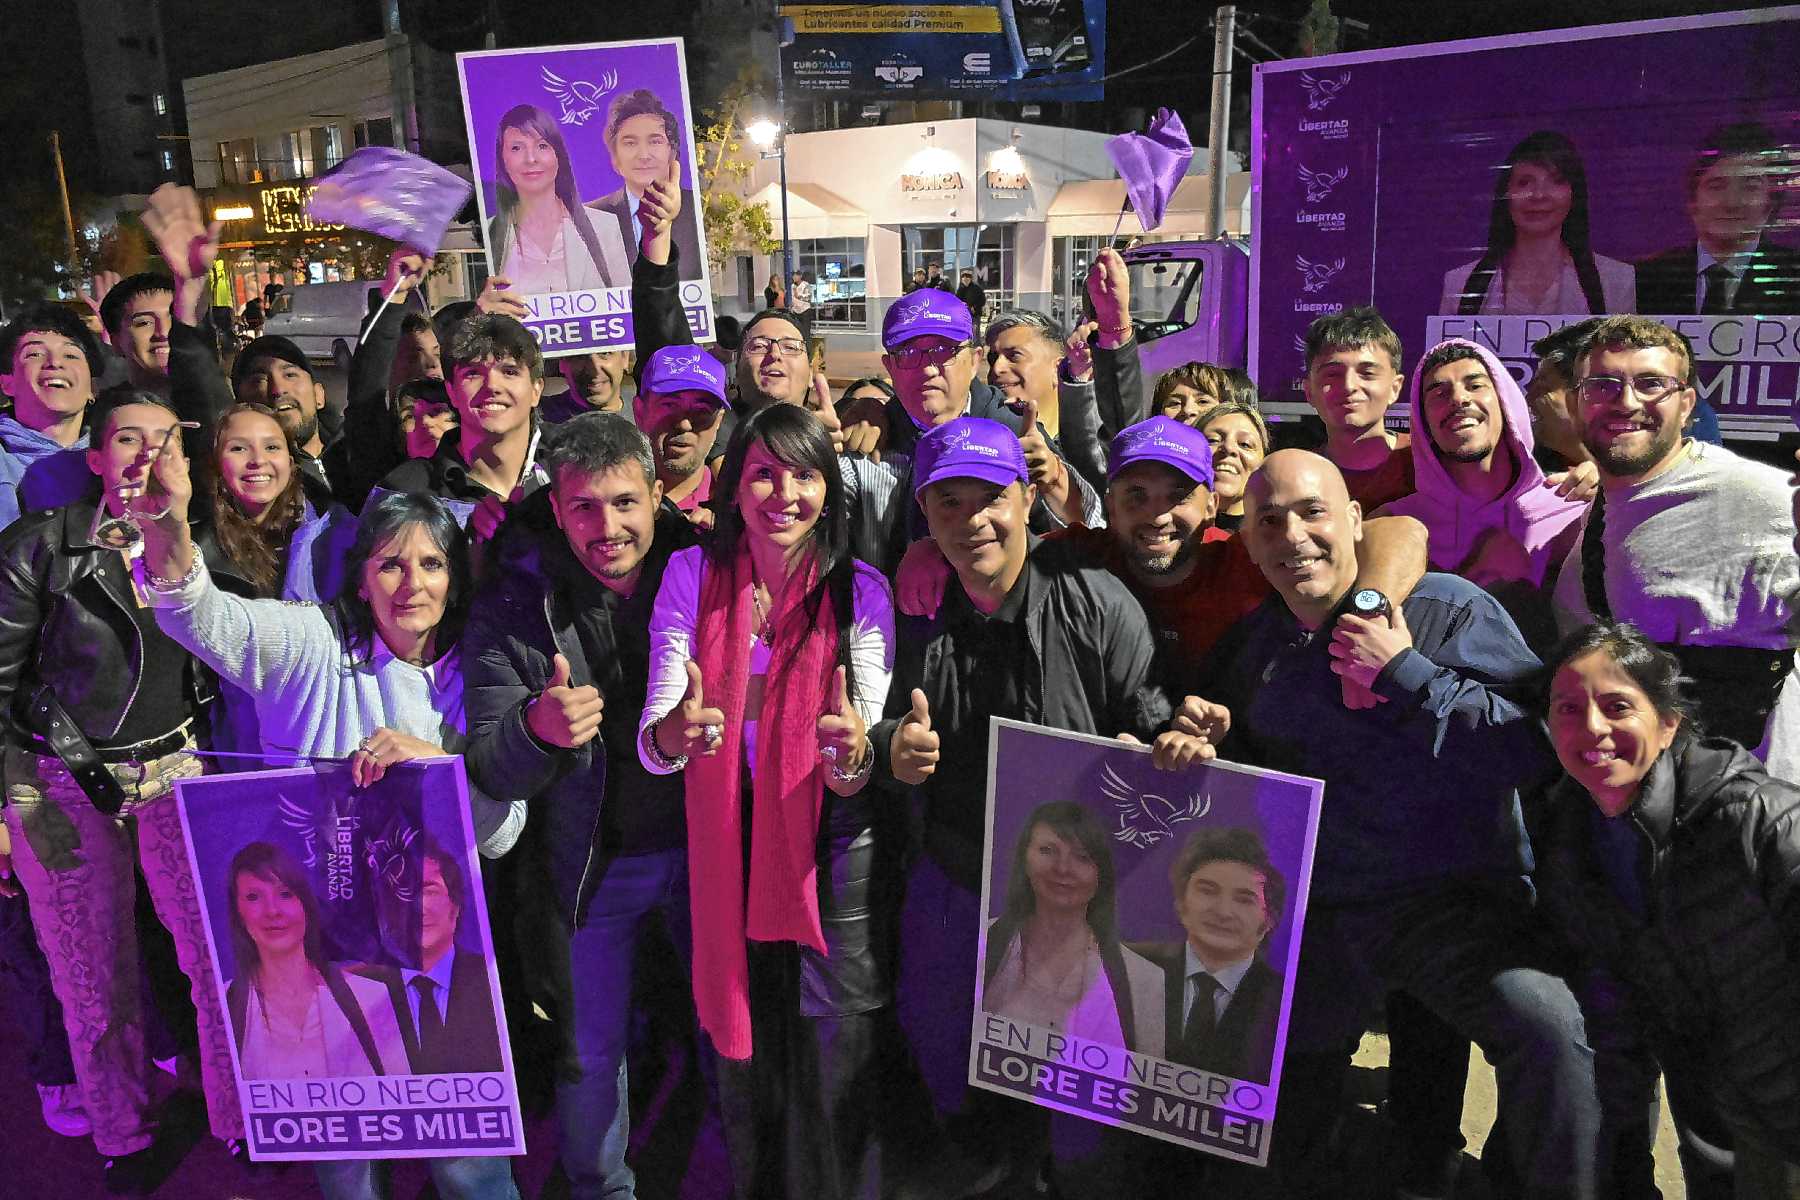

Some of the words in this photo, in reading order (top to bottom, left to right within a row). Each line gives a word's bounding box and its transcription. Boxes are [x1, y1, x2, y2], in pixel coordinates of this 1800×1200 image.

[803, 19, 868, 29] Lubricantes
[871, 19, 911, 29] calidad
[913, 19, 964, 29] Premium
[793, 61, 853, 69] EUROTALLER
[1298, 120, 1349, 132] LIBERTAD
[1296, 212, 1346, 223] LIBERTAD
[550, 293, 597, 317] RIO
[1294, 303, 1343, 312] LIBERTAD
[590, 318, 625, 341] ES
[1441, 319, 1502, 355] EN
[1696, 364, 1800, 406] MIL
[962, 444, 999, 454] LIBERTAD
[1154, 439, 1189, 453] LIBERTAD
[351, 816, 361, 832] LA
[336, 816, 354, 901] LIBERTAD
[328, 852, 339, 901] AVANZA
[985, 1016, 1031, 1052] EN
[1046, 1033, 1109, 1070] RIO
[1123, 1054, 1262, 1111] NEGRO
[249, 1082, 295, 1109] EN
[306, 1081, 366, 1107] RIO
[377, 1076, 505, 1105] NEGRO
[981, 1049, 1081, 1099] LORE
[1091, 1079, 1139, 1114] ES
[1152, 1096, 1260, 1148] MILEI
[255, 1116, 349, 1145] LORE
[358, 1114, 404, 1142] ES
[414, 1111, 512, 1141] MILEI
